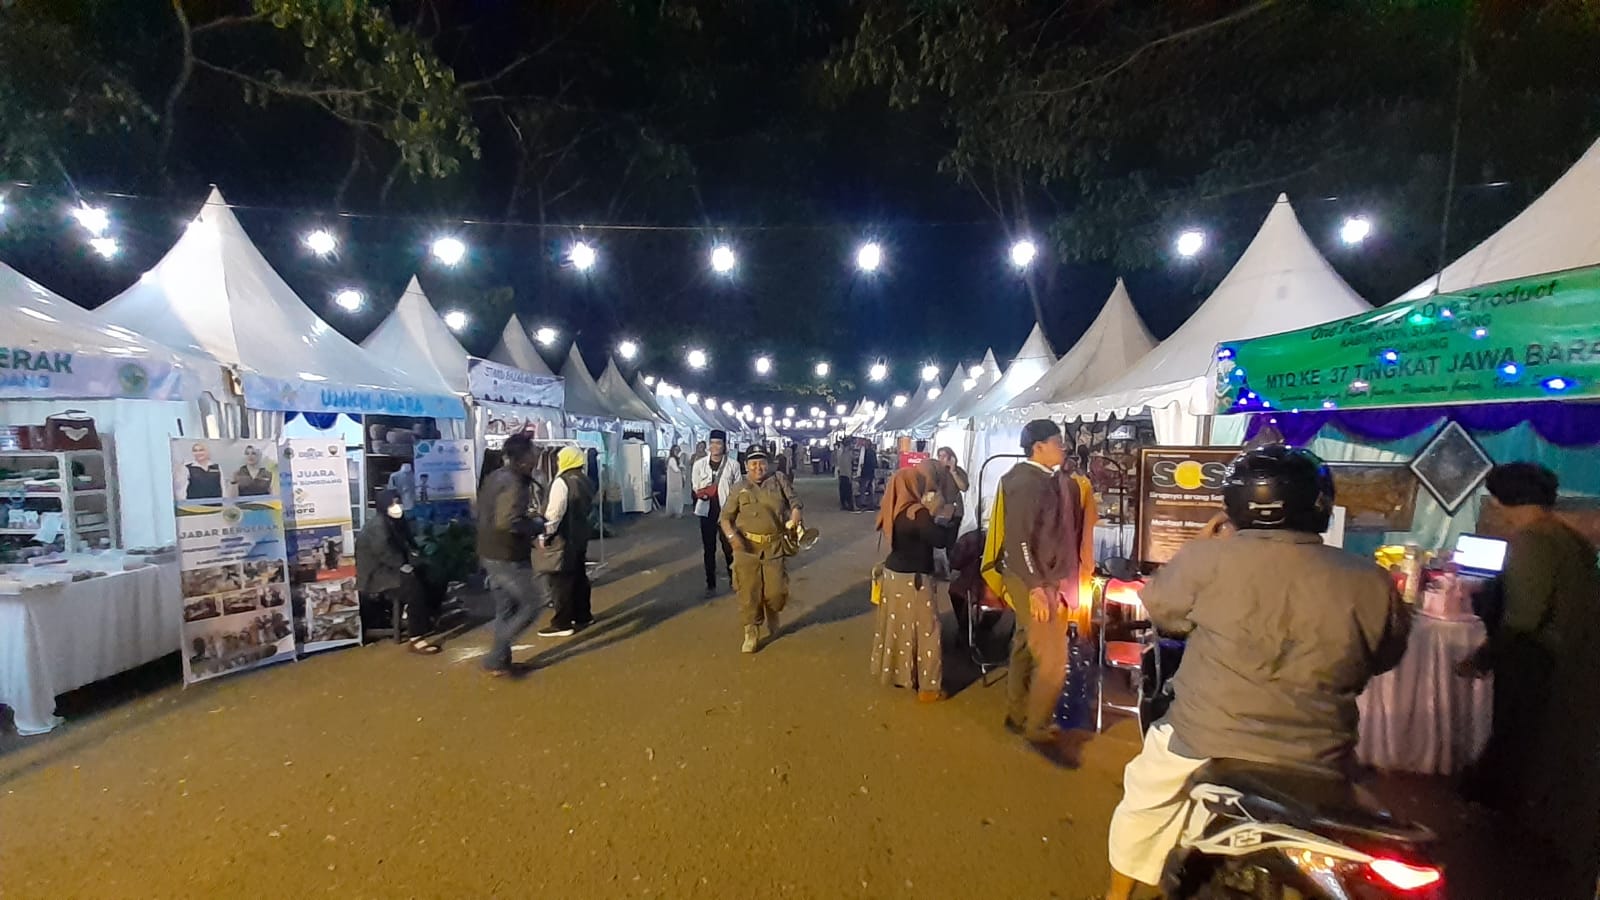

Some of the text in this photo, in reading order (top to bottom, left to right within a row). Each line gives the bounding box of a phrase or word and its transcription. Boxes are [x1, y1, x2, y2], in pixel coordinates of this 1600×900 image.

[1266, 373, 1296, 389] MTQ
[1300, 369, 1321, 386] KE
[1330, 366, 1348, 383] 37
[1353, 355, 1440, 381] TINGKAT
[1448, 346, 1516, 372] JAWA
[297, 469, 336, 478] JUARA
[1152, 460, 1227, 489] SOS
[180, 528, 219, 539] JABAR
